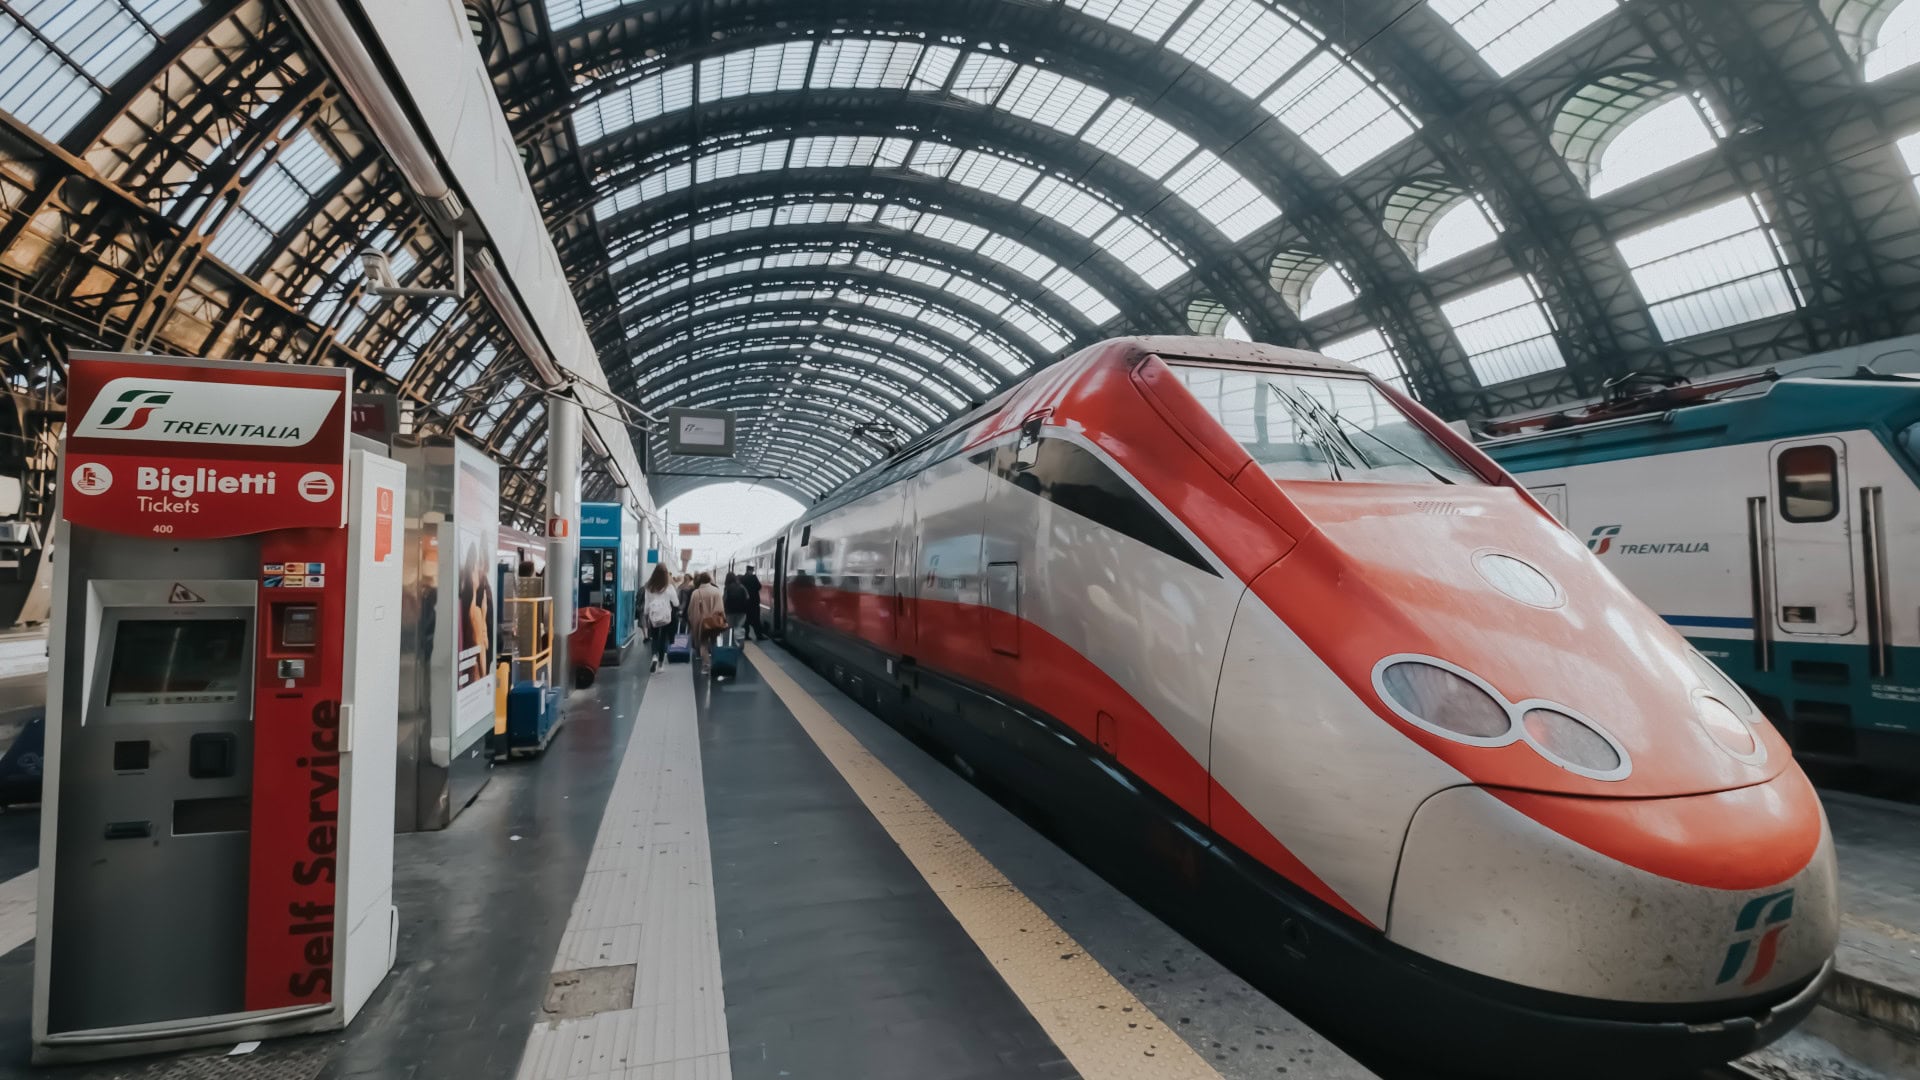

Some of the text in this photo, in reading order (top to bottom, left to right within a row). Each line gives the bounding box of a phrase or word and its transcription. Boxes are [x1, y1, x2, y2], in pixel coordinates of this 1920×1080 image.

[163, 420, 300, 440] TRENITALIA
[137, 466, 276, 498] Biglietti
[137, 495, 200, 514] Tickets
[152, 524, 174, 534] 400
[1620, 542, 1710, 555] TRENITALIA
[288, 699, 340, 998] Self Service
